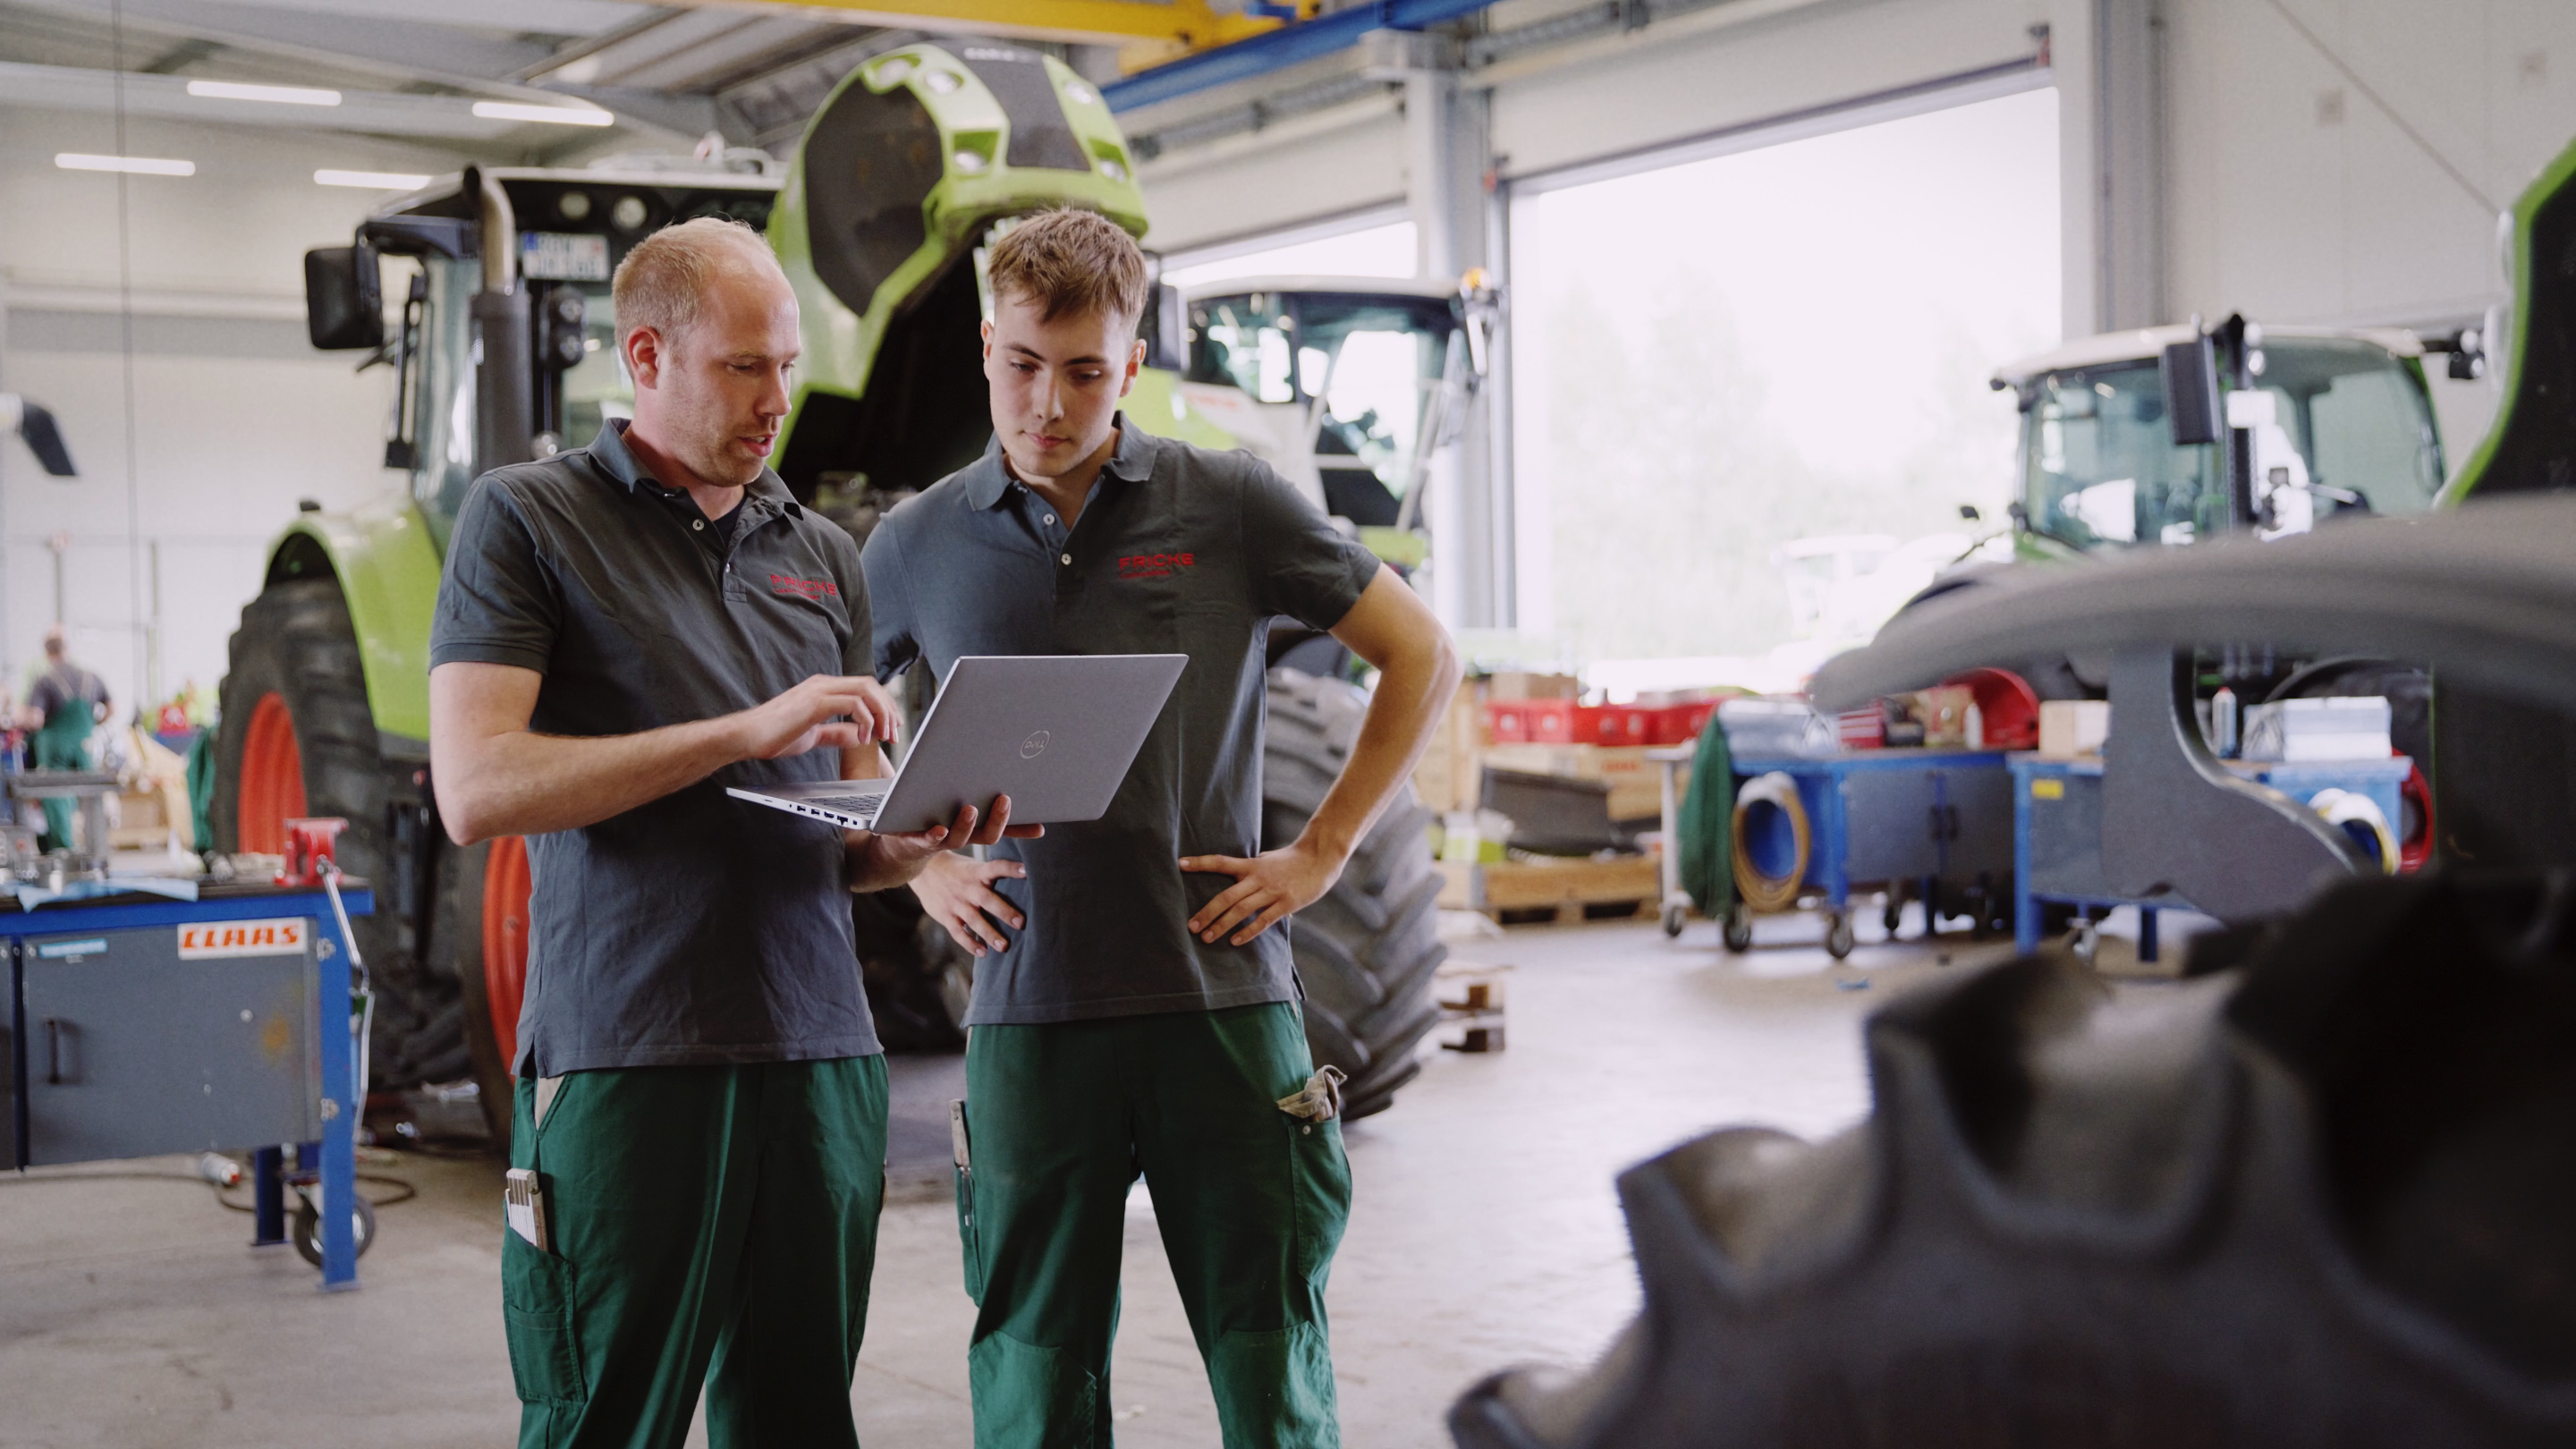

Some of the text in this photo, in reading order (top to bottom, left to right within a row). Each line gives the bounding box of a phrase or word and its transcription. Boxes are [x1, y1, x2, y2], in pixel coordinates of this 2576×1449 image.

[1118, 553, 1194, 571] FRICKE
[770, 574, 837, 597] FRICKE
[182, 925, 299, 949] CLAAS
